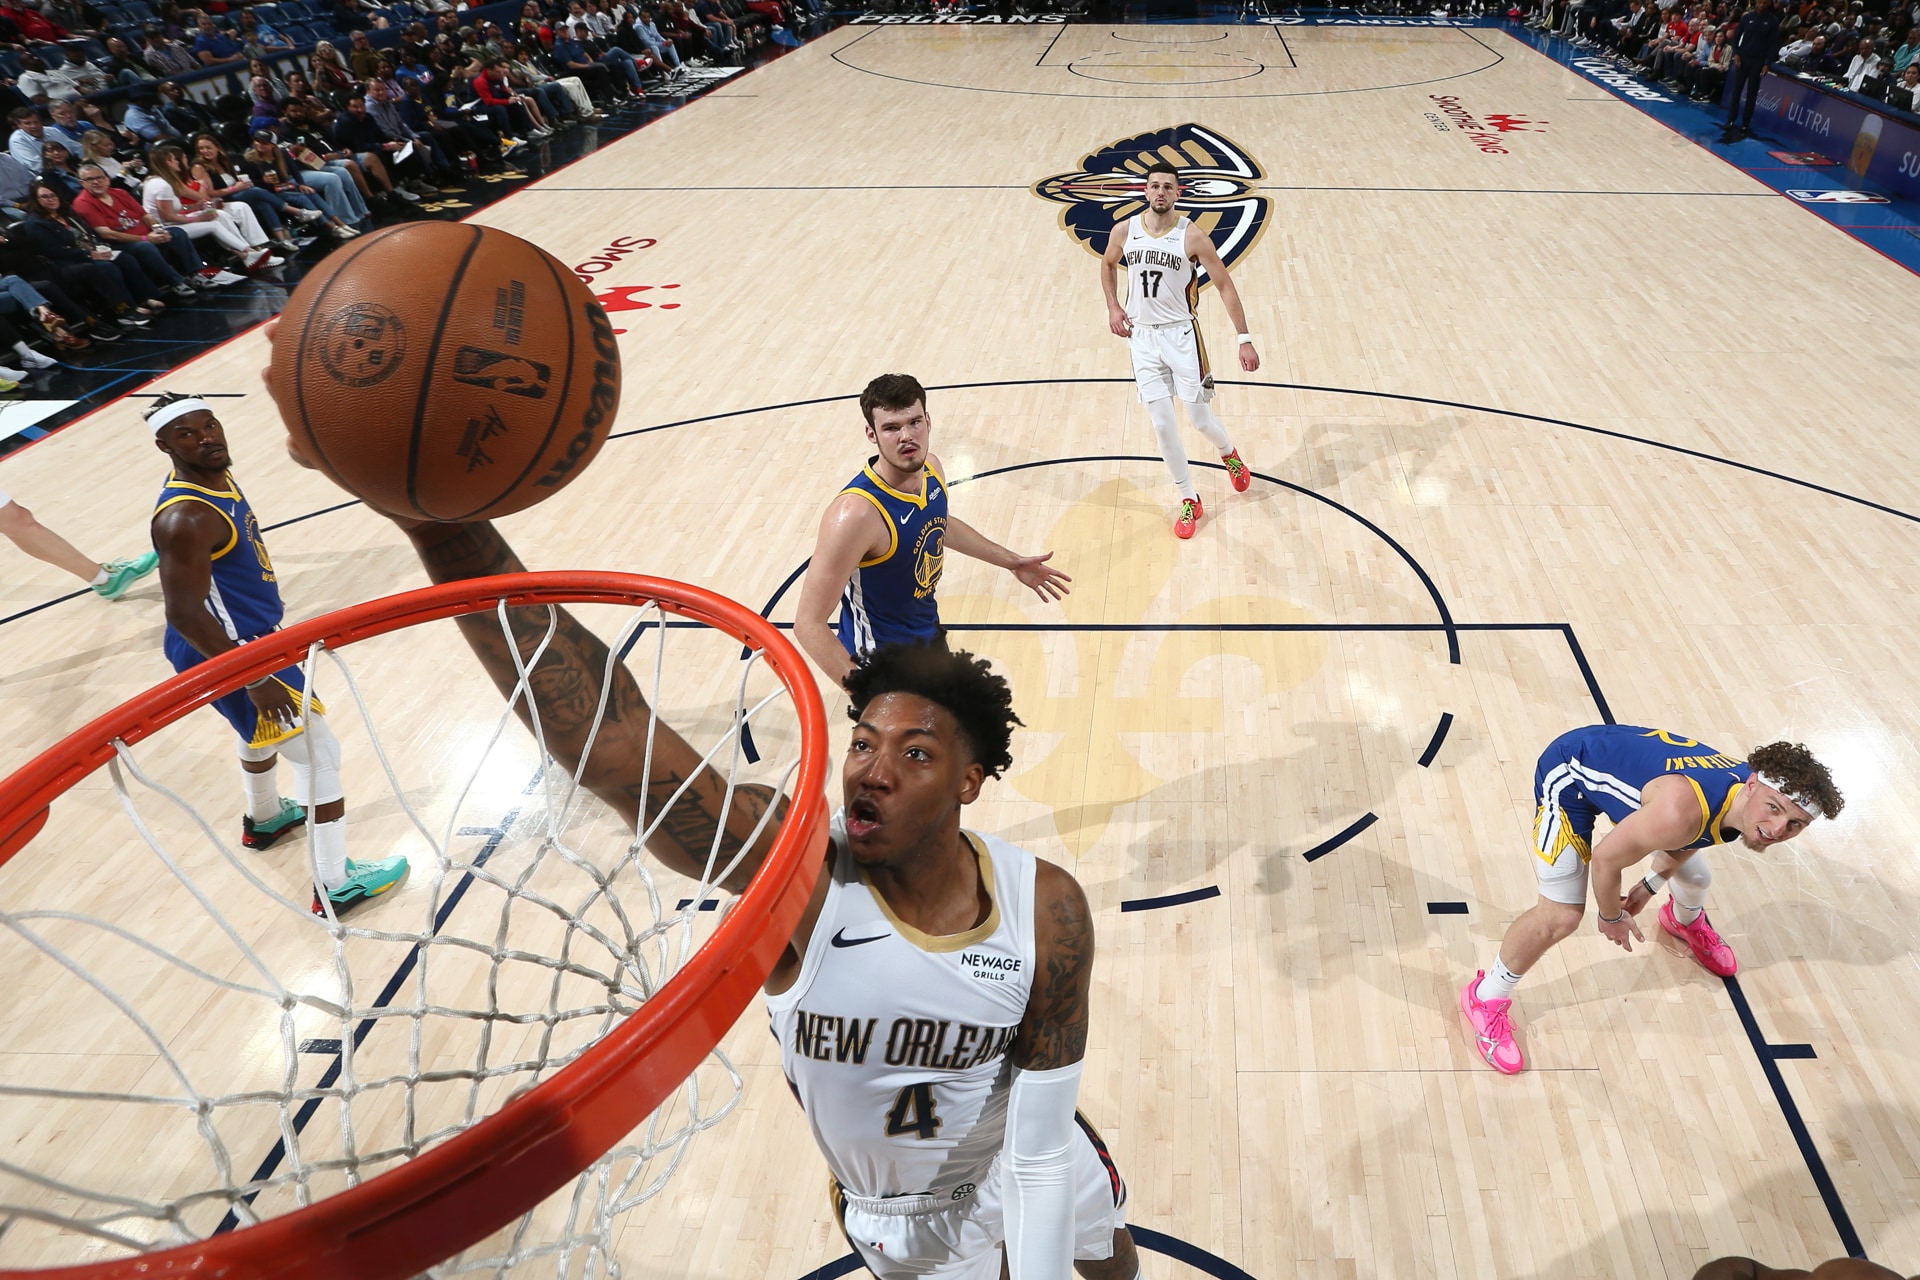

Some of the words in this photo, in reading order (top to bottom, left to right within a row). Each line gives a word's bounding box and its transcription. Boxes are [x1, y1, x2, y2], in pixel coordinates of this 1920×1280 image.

[850, 14, 1068, 24] PELICANS
[1315, 18, 1474, 26] FANDUEL
[1573, 61, 1674, 102] Ochsner
[1423, 112, 1450, 132] CENTER
[1429, 94, 1485, 131] SMOOTHIE
[1464, 131, 1509, 154] KING
[1788, 106, 1831, 136] ULTRA
[1127, 250, 1144, 266] NEW
[1145, 250, 1181, 271] ORLEANS
[1140, 270, 1163, 298] 17
[913, 519, 932, 554] GOLDEN
[961, 952, 1022, 972] NEWAGE
[973, 970, 1005, 981] GRILLS
[795, 1009, 879, 1065] NEW
[884, 1016, 1018, 1070] ORLEAN
[884, 1082, 943, 1140] 4
